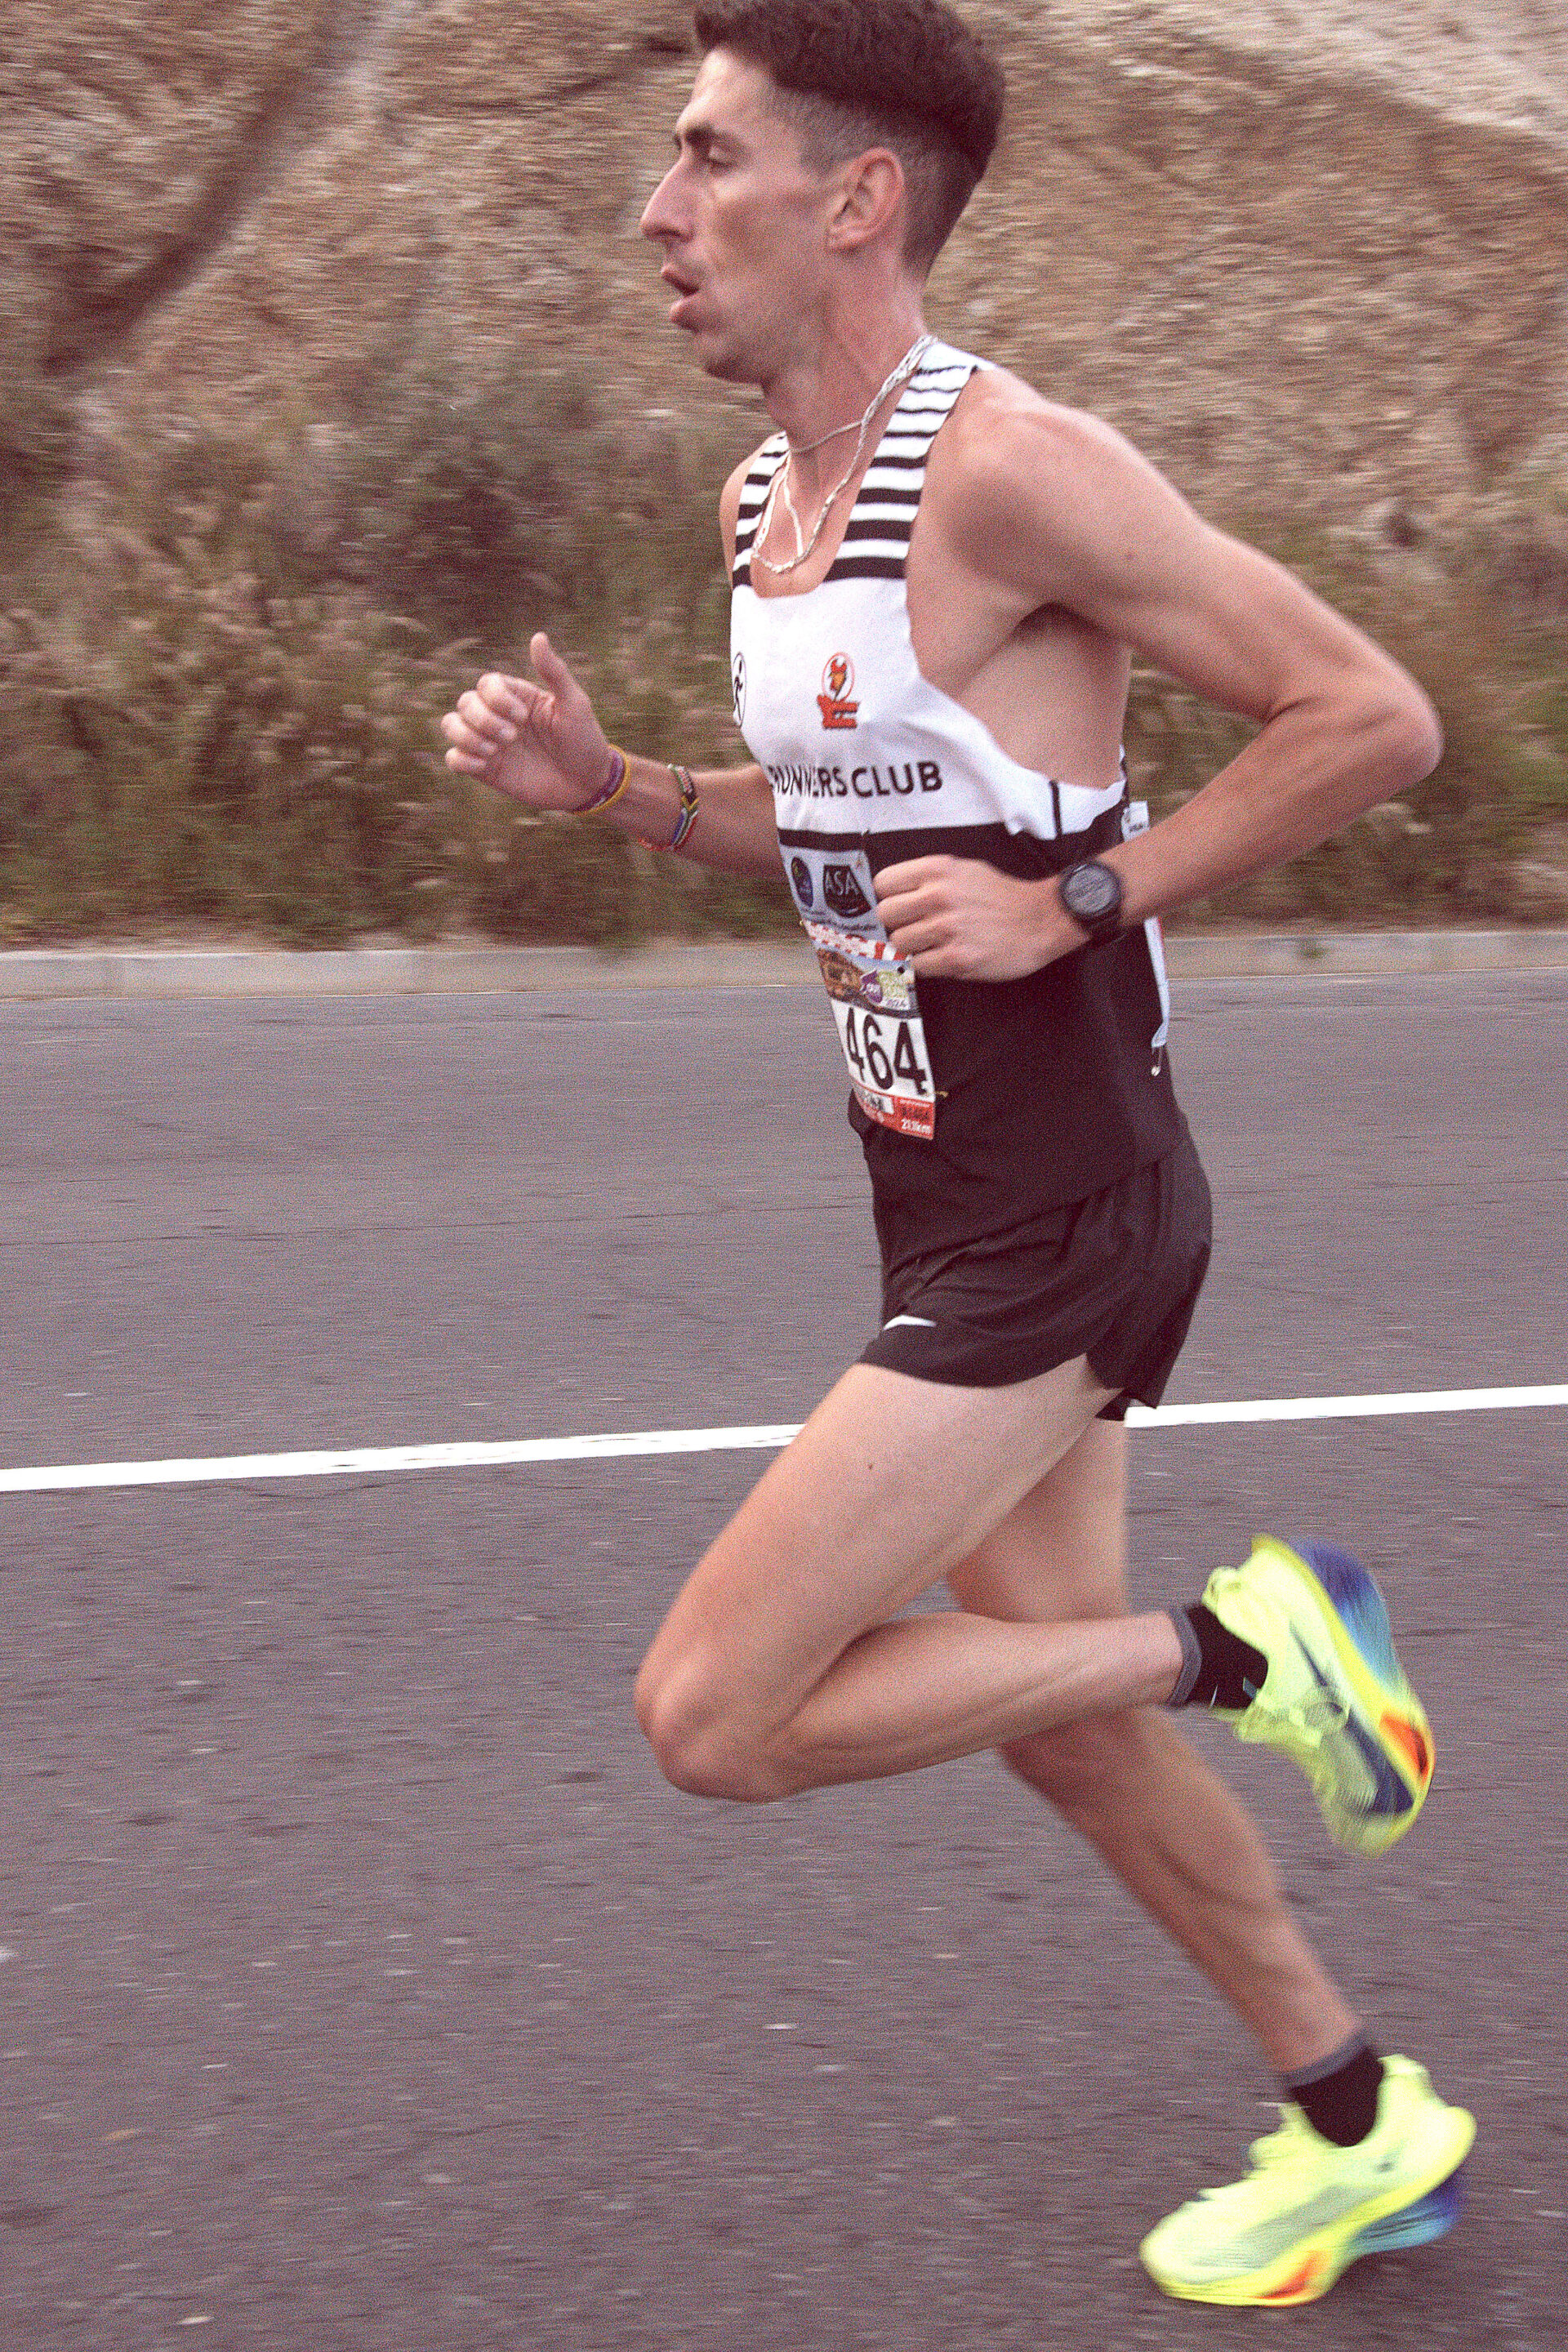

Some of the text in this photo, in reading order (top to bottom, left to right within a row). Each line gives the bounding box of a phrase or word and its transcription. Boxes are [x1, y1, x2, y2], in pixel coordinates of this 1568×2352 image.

[851, 760, 942, 798] CLUB
[825, 870, 858, 897] ASA
[846, 1007, 927, 1095] 464
